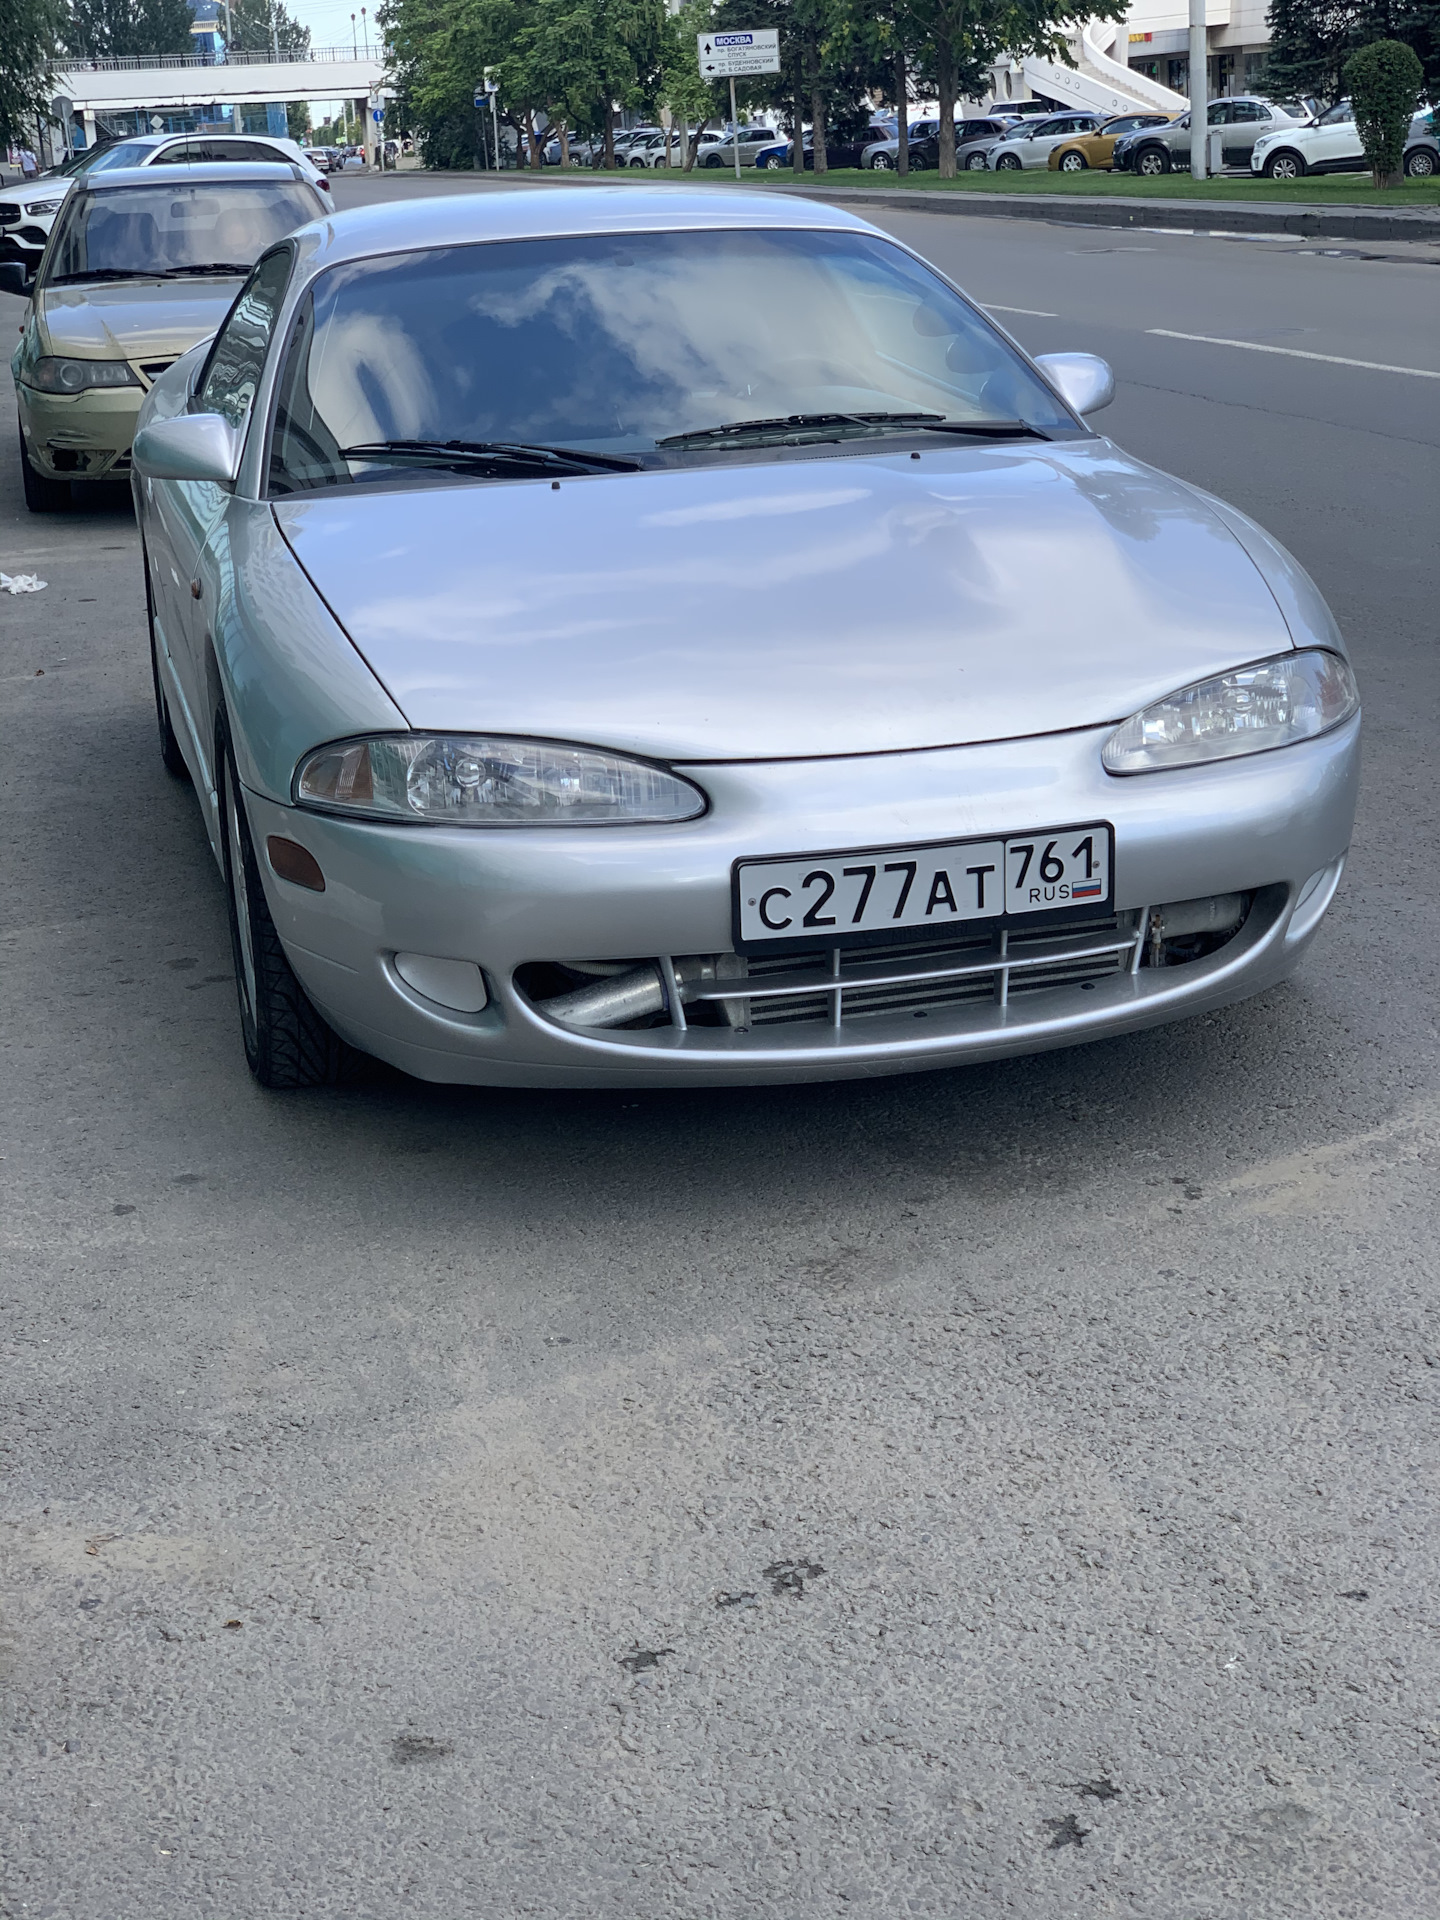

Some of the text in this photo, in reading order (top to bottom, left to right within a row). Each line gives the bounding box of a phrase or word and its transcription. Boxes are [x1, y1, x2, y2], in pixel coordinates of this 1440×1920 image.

[716, 36, 752, 45] МОСКВА
[727, 43, 776, 52] БОГАТЯНОВСКИЙ
[728, 58, 774, 66] БУДЕННОВСКИЙ
[758, 836, 1094, 930] С277АТ 761
[1029, 884, 1070, 903] RUS
